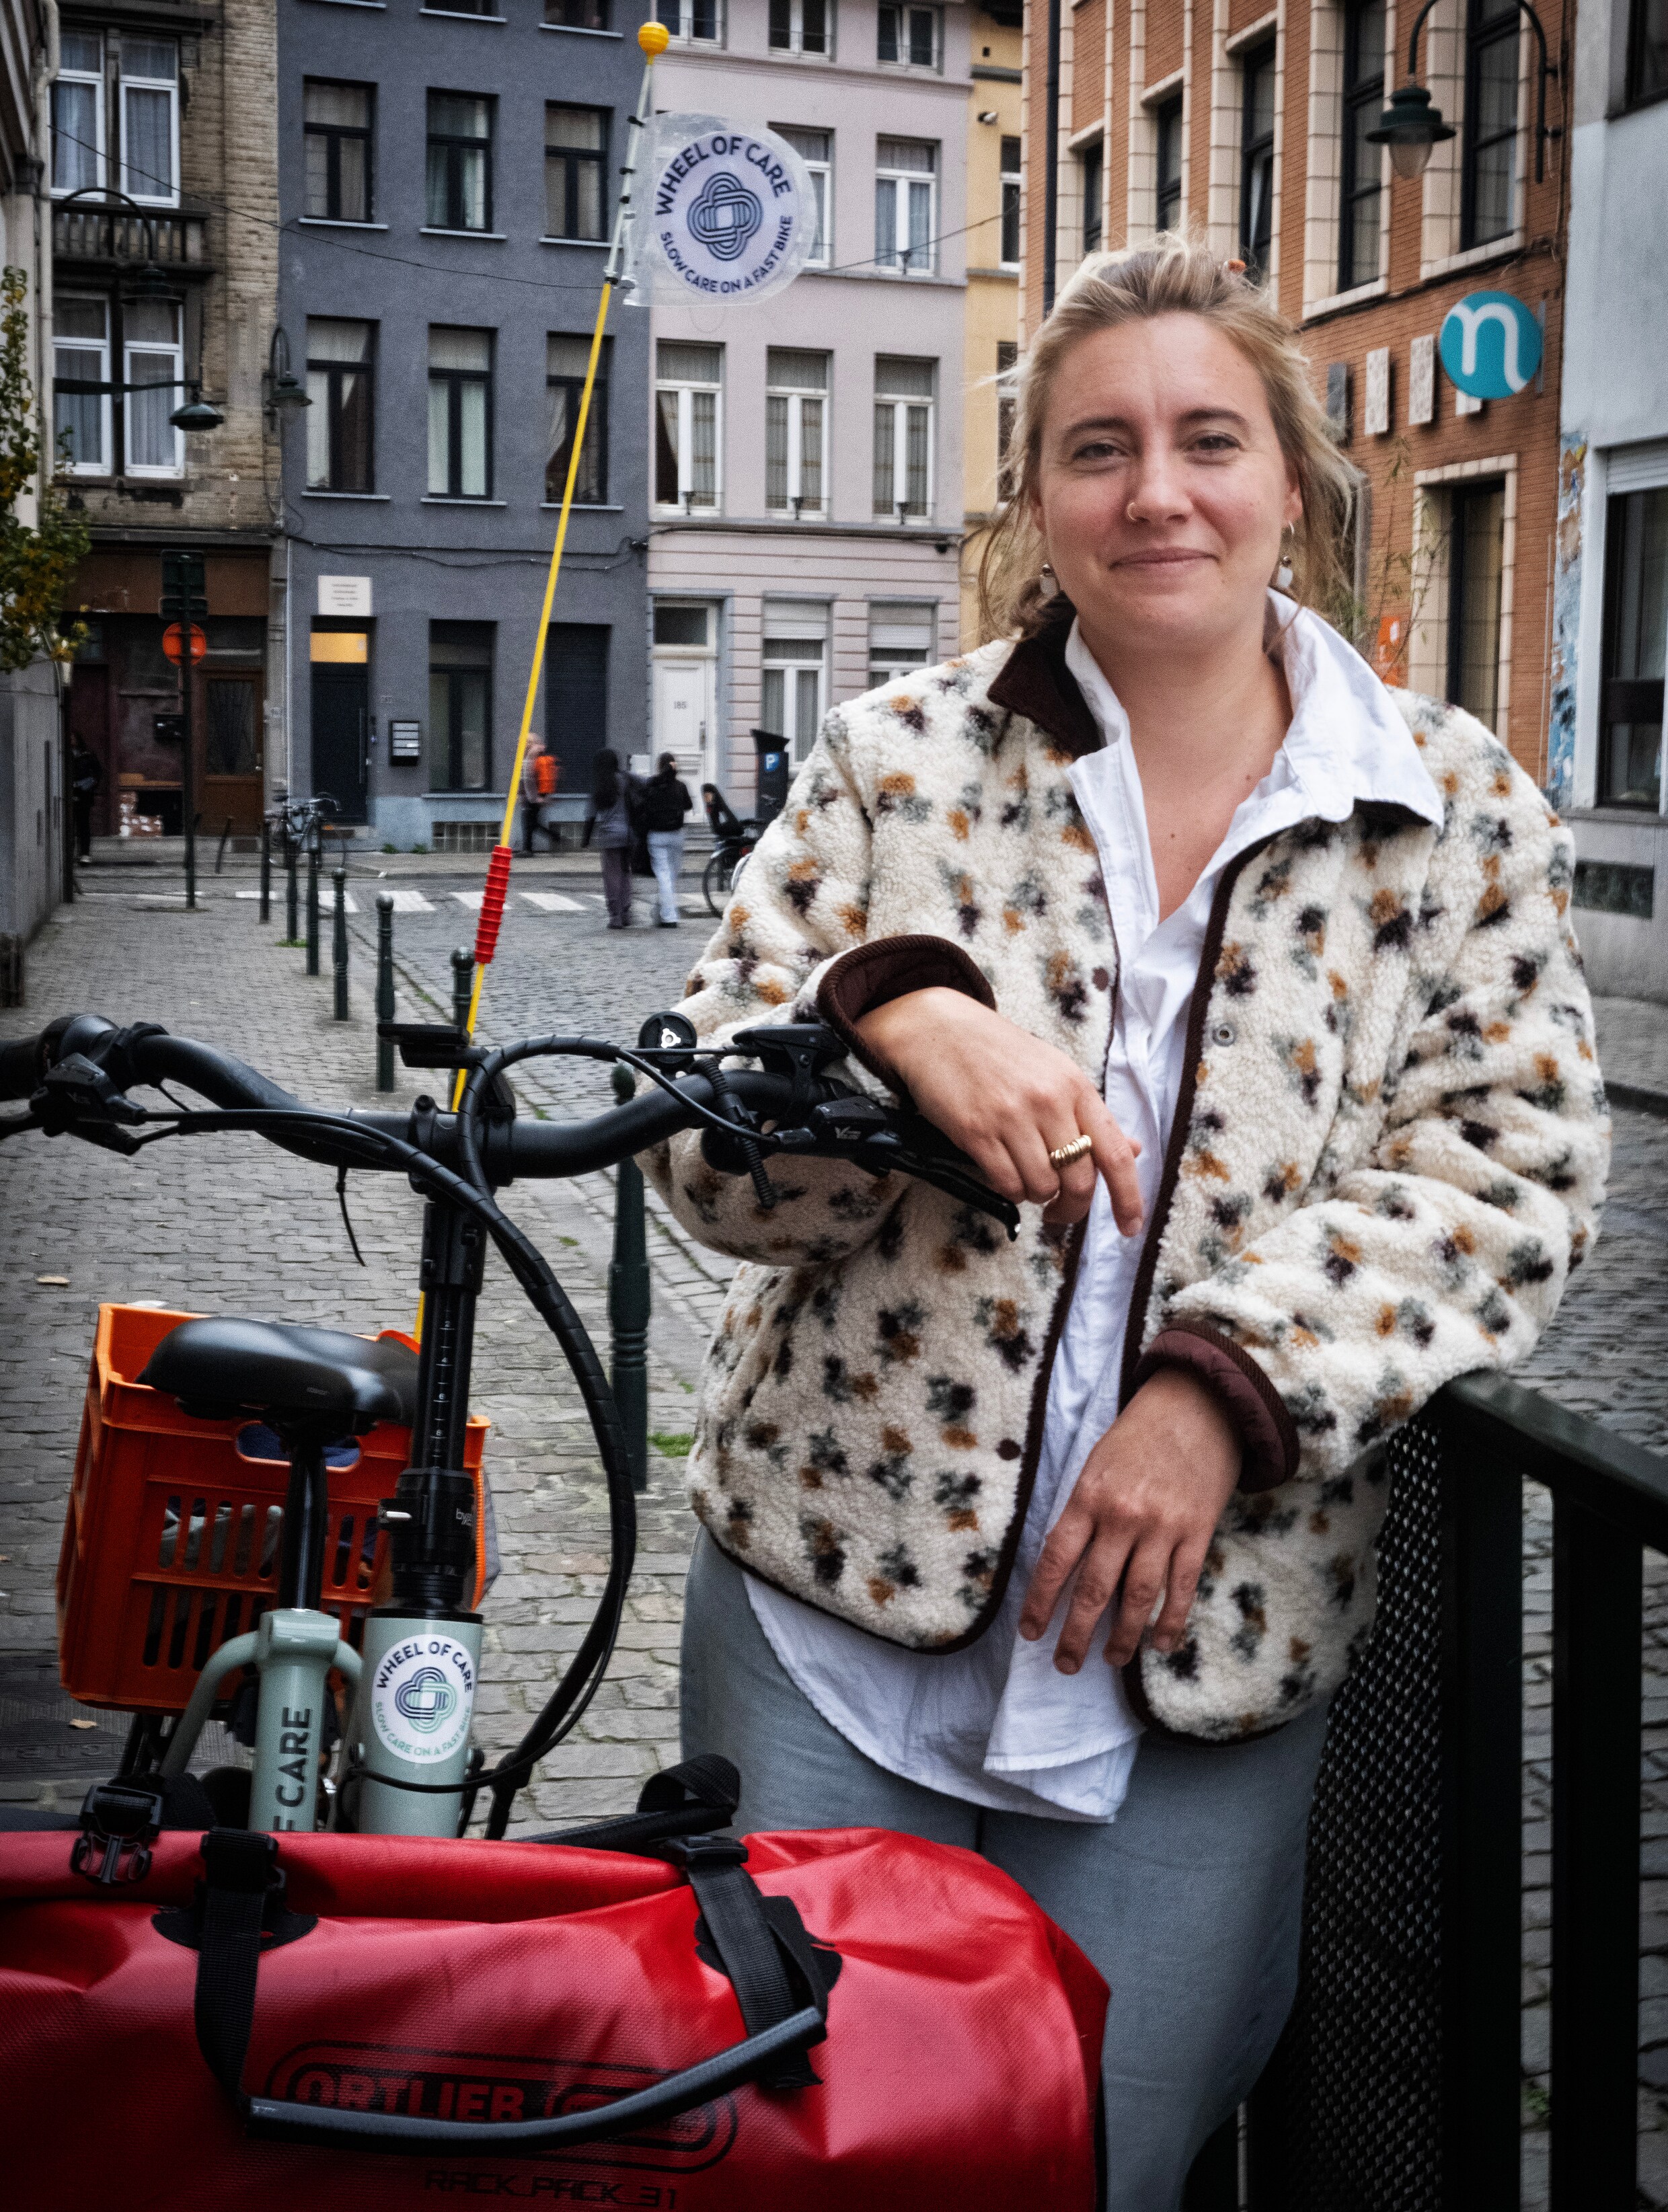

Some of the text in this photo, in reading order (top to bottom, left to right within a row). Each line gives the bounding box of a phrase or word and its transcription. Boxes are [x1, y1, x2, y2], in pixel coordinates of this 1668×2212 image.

[655, 136, 792, 215] WHEEL OF CARE
[660, 216, 792, 294] SLOW CARE ON A FAST BIKE
[765, 753, 775, 769] P
[377, 1641, 472, 1693] WHEEL OF CARE
[375, 1702, 388, 1732] SLOW
[387, 1733, 414, 1754] CARE
[414, 1747, 430, 1756] ON
[433, 1746, 441, 1755] A
[443, 1733, 462, 1751] FAST
[276, 1707, 313, 1808] CARE
[295, 2070, 525, 2123] ORTLIEB
